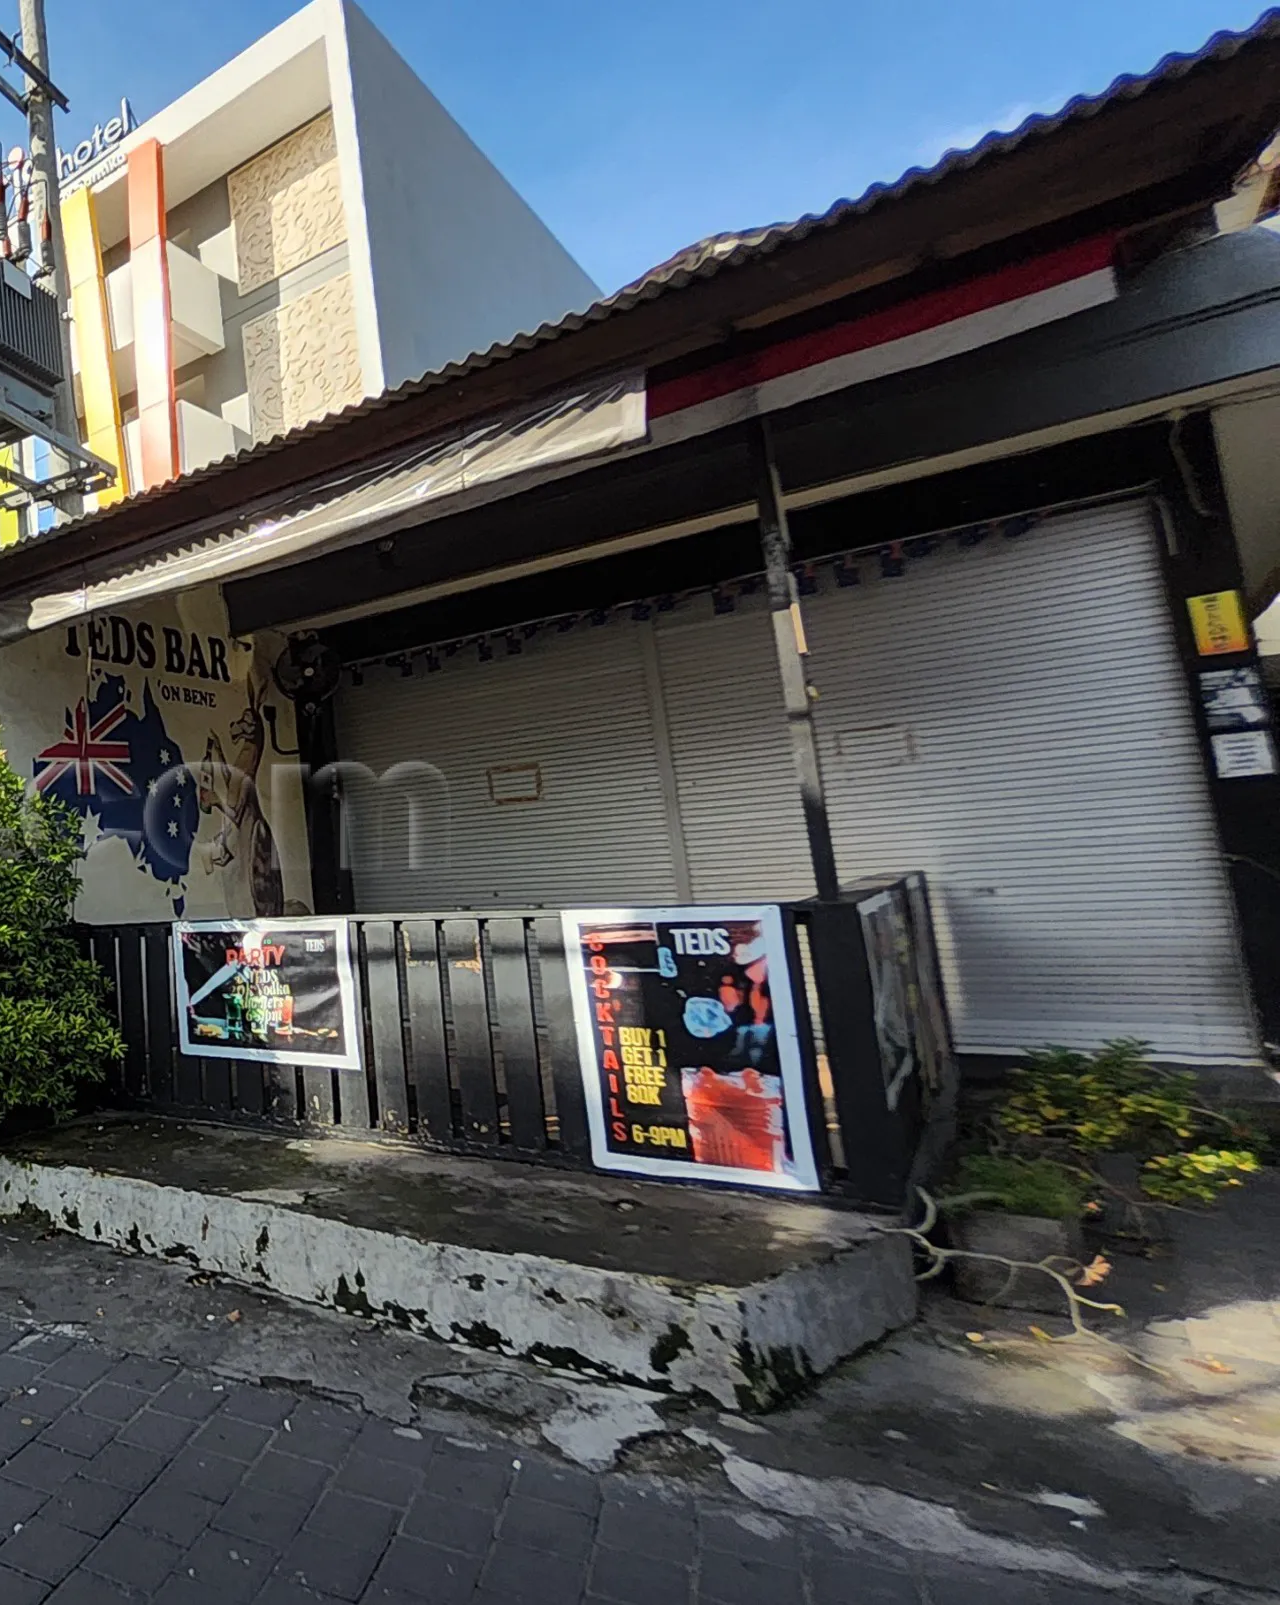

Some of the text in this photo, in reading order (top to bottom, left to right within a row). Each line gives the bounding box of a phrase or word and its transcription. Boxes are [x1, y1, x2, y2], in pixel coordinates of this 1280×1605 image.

[56, 97, 134, 180] hotel
[162, 626, 231, 683] BAR
[183, 686, 217, 708] BENE
[670, 928, 731, 956] TEDS
[225, 945, 285, 967] PARTY
[588, 935, 626, 1142] COCKTAILS
[618, 1026, 667, 1047] BUY 1
[621, 1046, 667, 1067] GET 1
[623, 1065, 667, 1087] FREE
[632, 1124, 687, 1148] 6-9PM
